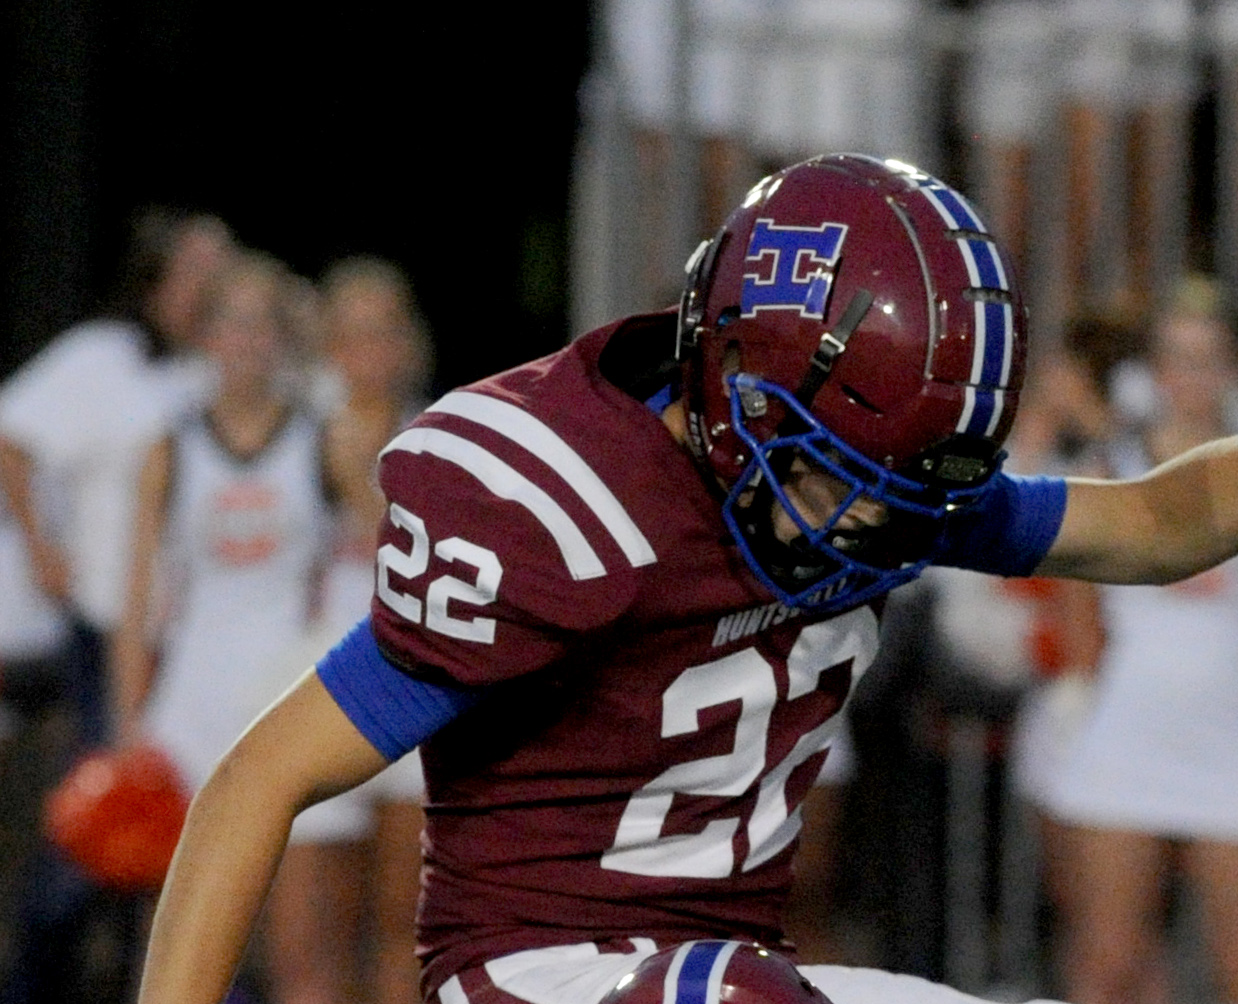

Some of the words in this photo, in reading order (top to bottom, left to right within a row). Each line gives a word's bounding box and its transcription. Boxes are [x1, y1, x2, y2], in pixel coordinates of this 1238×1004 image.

[740, 218, 848, 320] H
[377, 502, 504, 645] 22
[601, 604, 879, 878] 22
